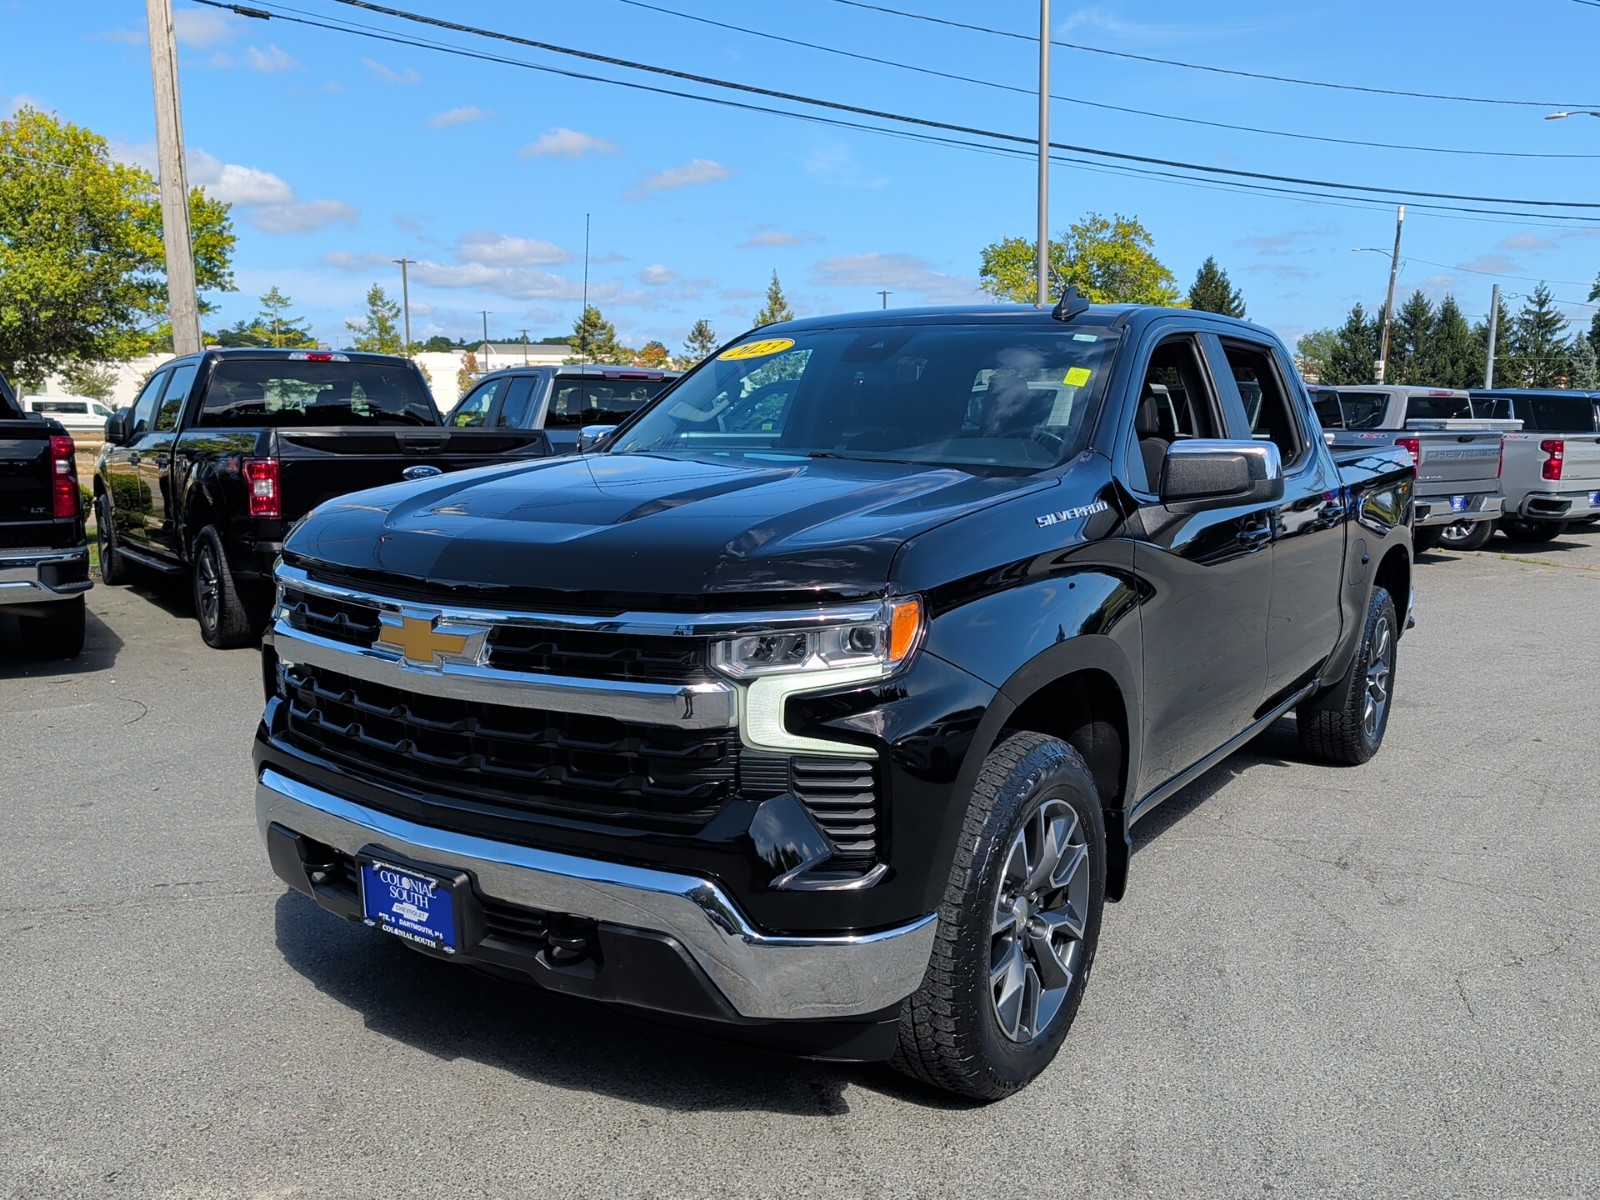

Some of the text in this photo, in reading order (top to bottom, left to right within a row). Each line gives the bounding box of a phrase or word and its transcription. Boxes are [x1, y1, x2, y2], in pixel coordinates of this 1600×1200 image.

[1036, 501, 1108, 527] SILVERADO
[380, 870, 436, 899] COLONIAL
[390, 886, 429, 909] SOUTH
[395, 904, 426, 919] CHEVROLET
[382, 924, 436, 949] COLONIAL SOUTH
[399, 918, 434, 937] DARTMOUTH,
